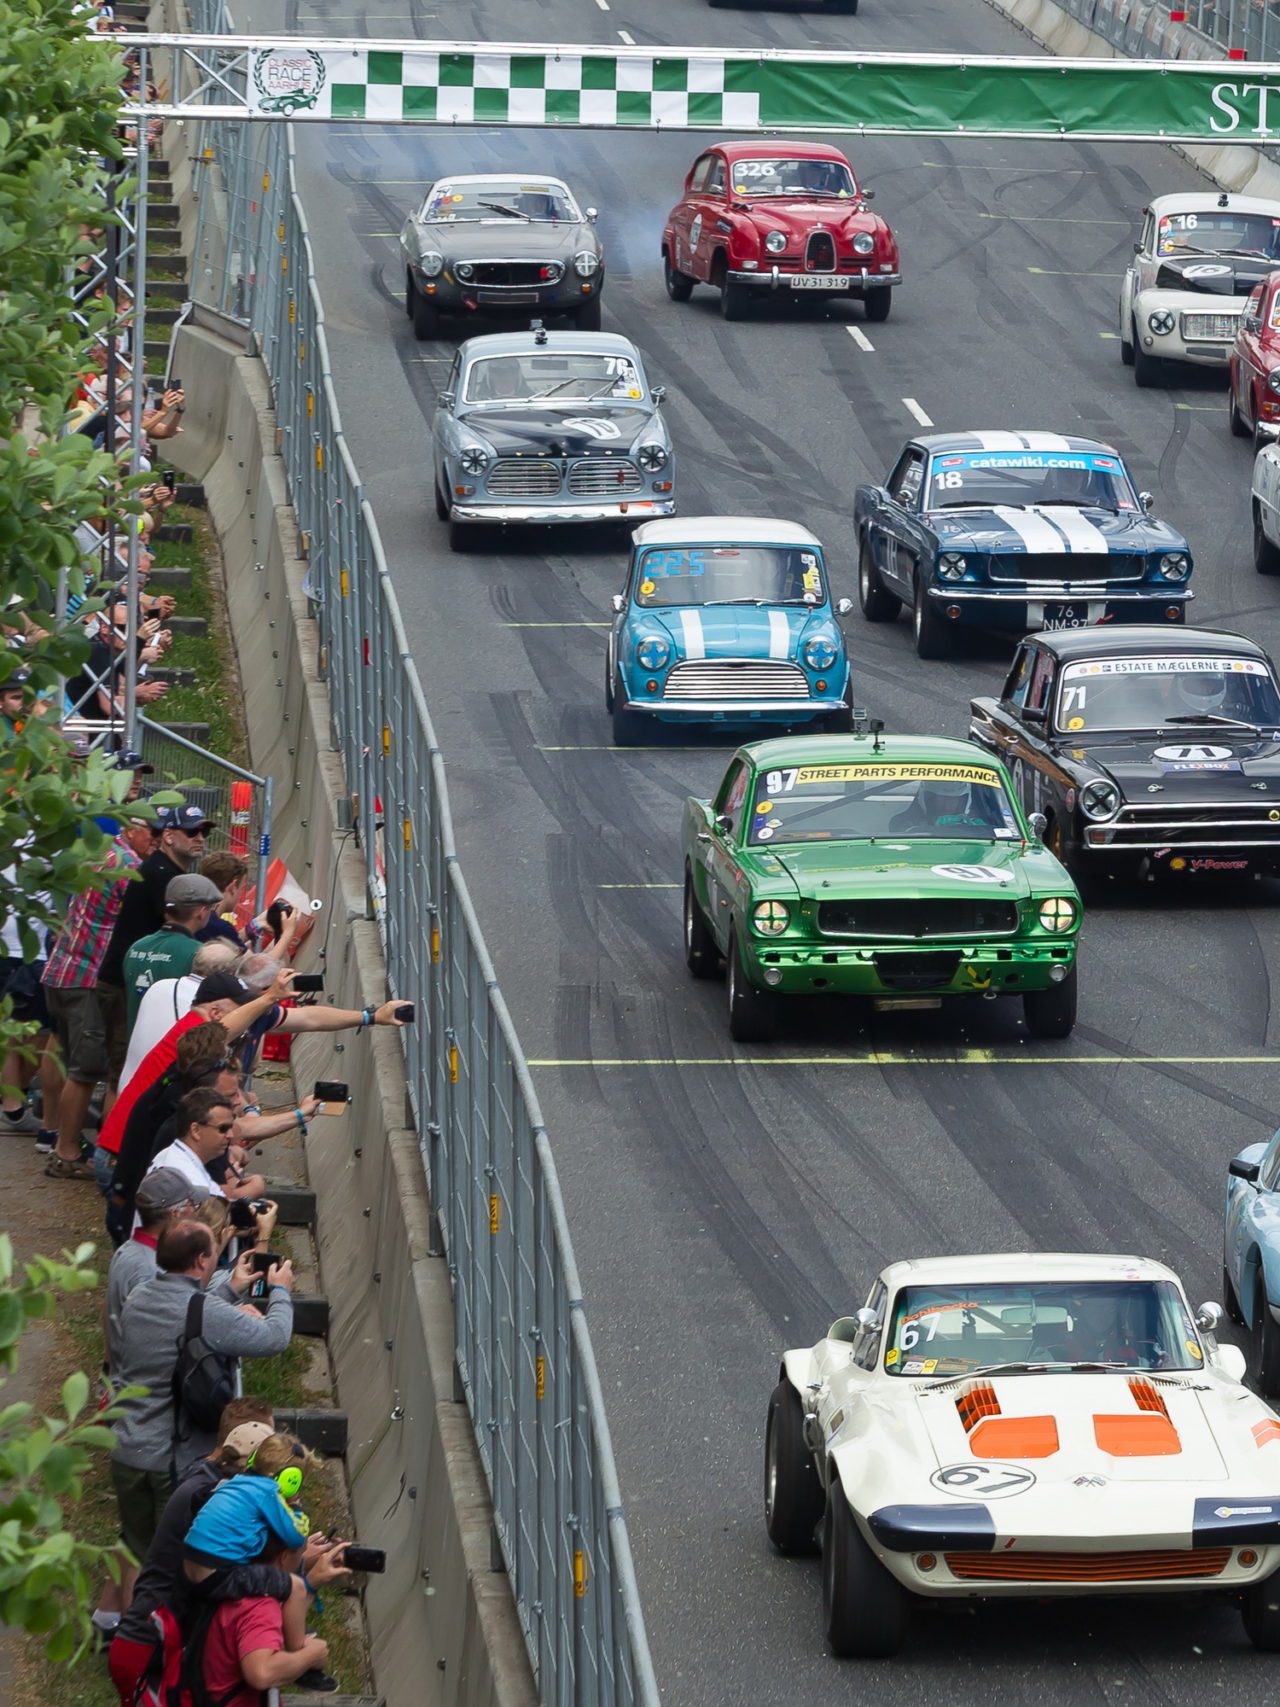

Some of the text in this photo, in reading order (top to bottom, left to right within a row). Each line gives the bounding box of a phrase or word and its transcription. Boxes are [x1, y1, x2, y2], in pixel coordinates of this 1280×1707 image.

[268, 58, 312, 67] CLASSIC
[268, 67, 312, 81] RACE
[268, 81, 312, 89] AARHUS
[734, 163, 776, 176] 326
[1177, 214, 1198, 230] 16
[792, 276, 848, 288] UV 31 319
[604, 357, 629, 376] 76
[969, 457, 1086, 469] catawiki.com
[935, 471, 963, 490] 18
[645, 551, 704, 578] 225
[1057, 606, 1075, 618] 76
[1115, 661, 1220, 672] ESTATE MÆGLERNE
[1062, 686, 1087, 712] 71
[1177, 747, 1213, 758] 71
[1173, 762, 1230, 771] FLEXBOX
[766, 768, 797, 794] 97
[800, 767, 999, 783] STREET PARTS PERFORMANCE
[1191, 859, 1248, 870] V-Power
[948, 865, 997, 880] 97
[900, 1312, 941, 1351] 67
[942, 1466, 1033, 1494] 67
